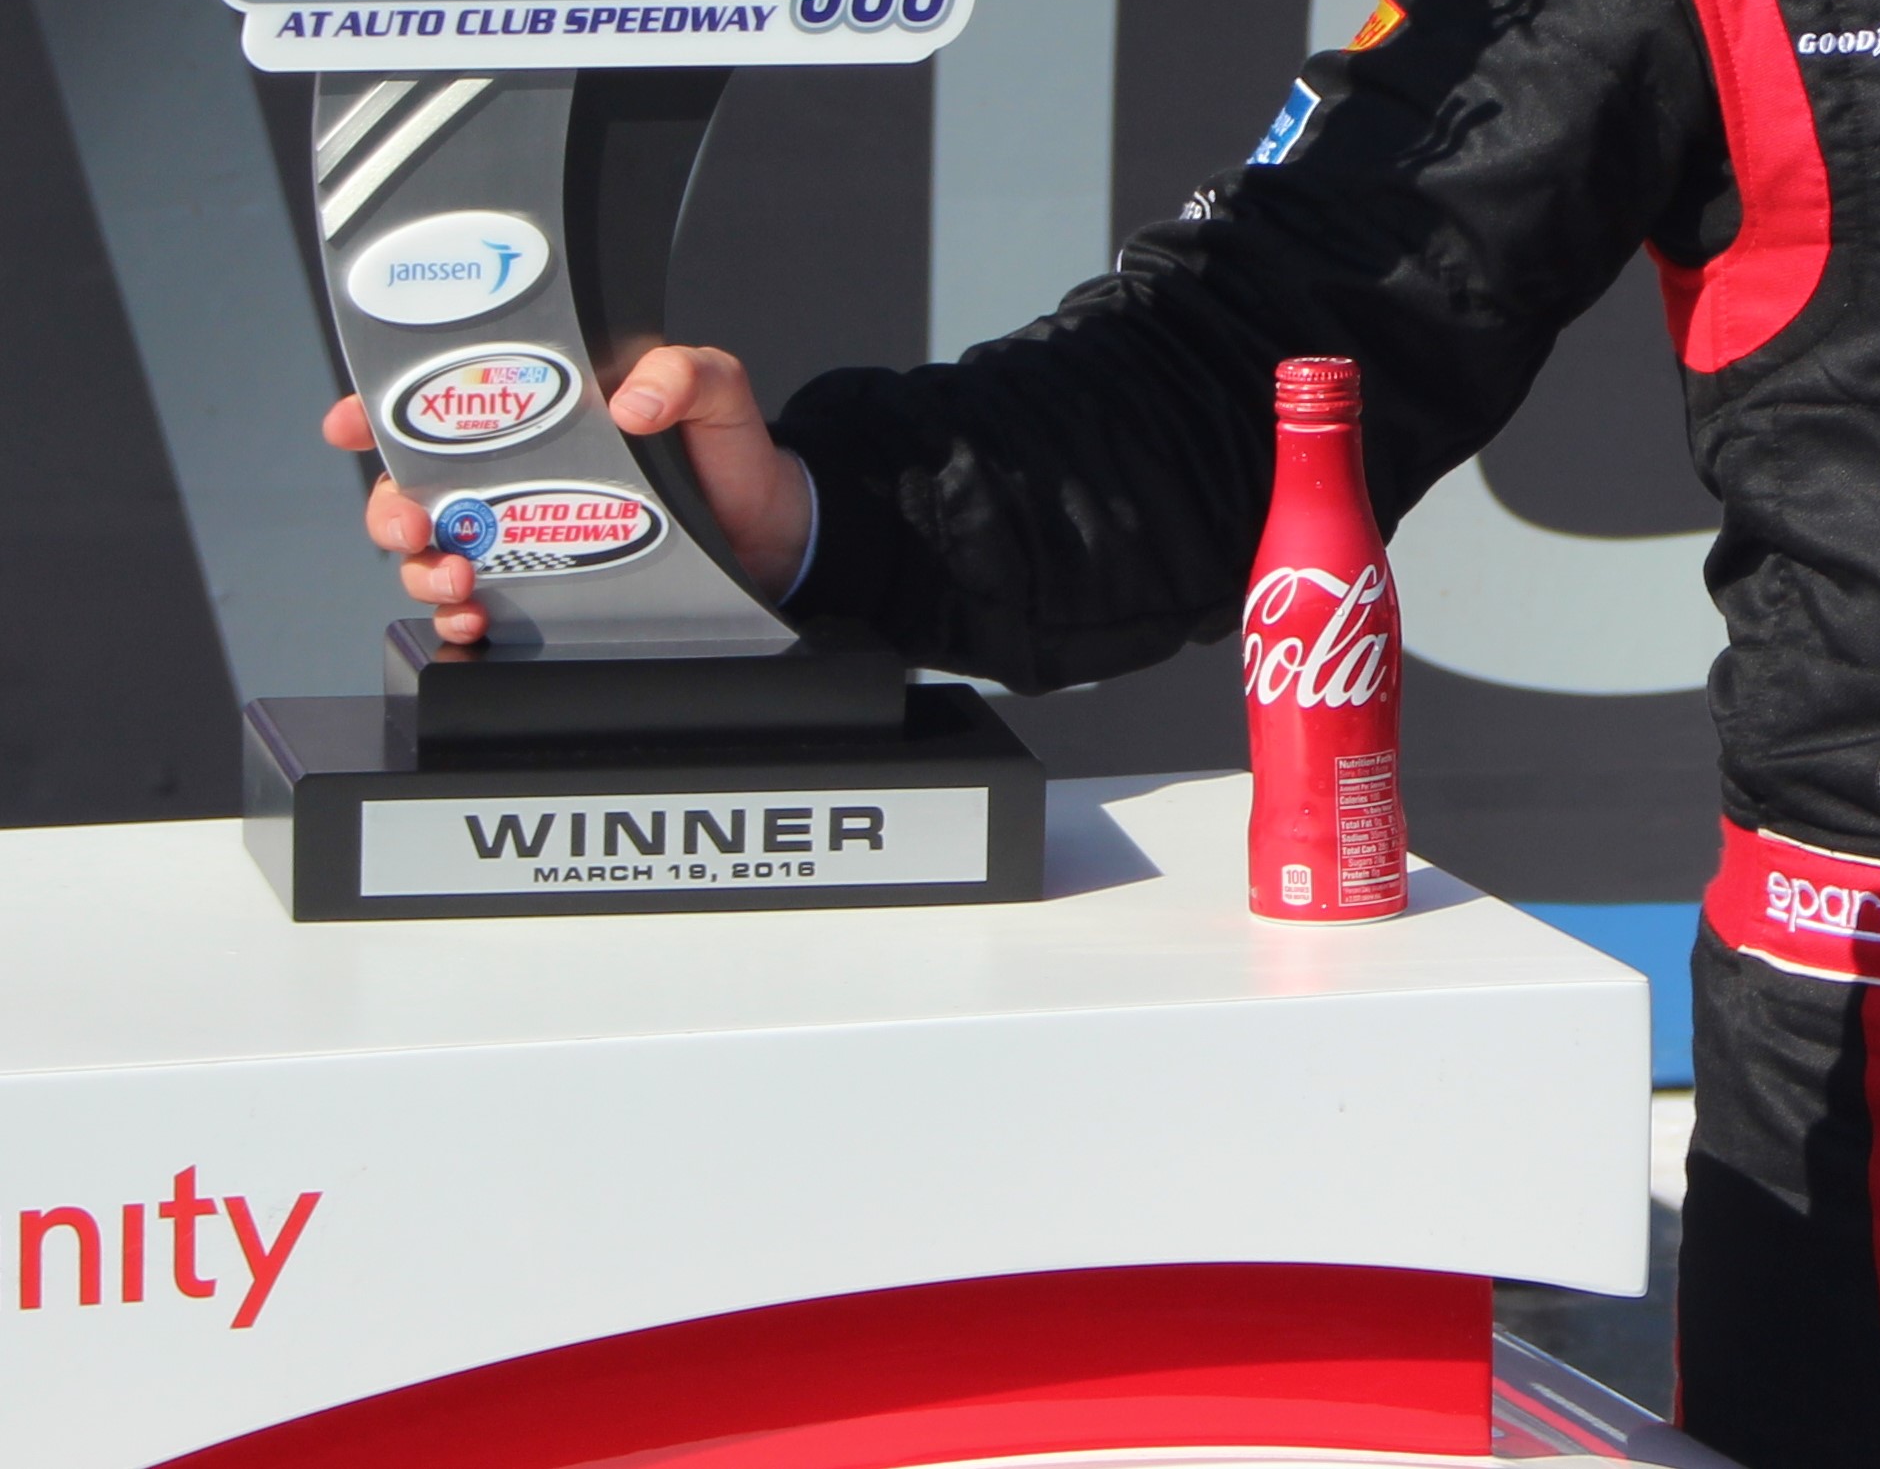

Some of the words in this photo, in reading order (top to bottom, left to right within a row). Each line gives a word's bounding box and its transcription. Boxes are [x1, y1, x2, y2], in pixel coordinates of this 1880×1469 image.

[276, 10, 333, 39] AT
[333, 9, 445, 38] AUTO
[456, 7, 558, 36] CLUB
[563, 5, 778, 34] SPEEDWAY
[386, 259, 482, 288] janssen
[487, 366, 549, 384] NASCAR
[420, 386, 537, 422] xfinity
[455, 419, 501, 431] SERIES
[499, 502, 569, 522] AUTO
[575, 501, 643, 520] CLUB
[453, 520, 481, 536] AAA
[502, 525, 640, 544] SPEEDWAY
[464, 806, 886, 860] WINNER
[532, 865, 654, 884] MARCH
[667, 862, 719, 885] 19,
[731, 860, 816, 880] 2016
[1286, 869, 1308, 885] 100
[19, 1163, 323, 1330] nity
